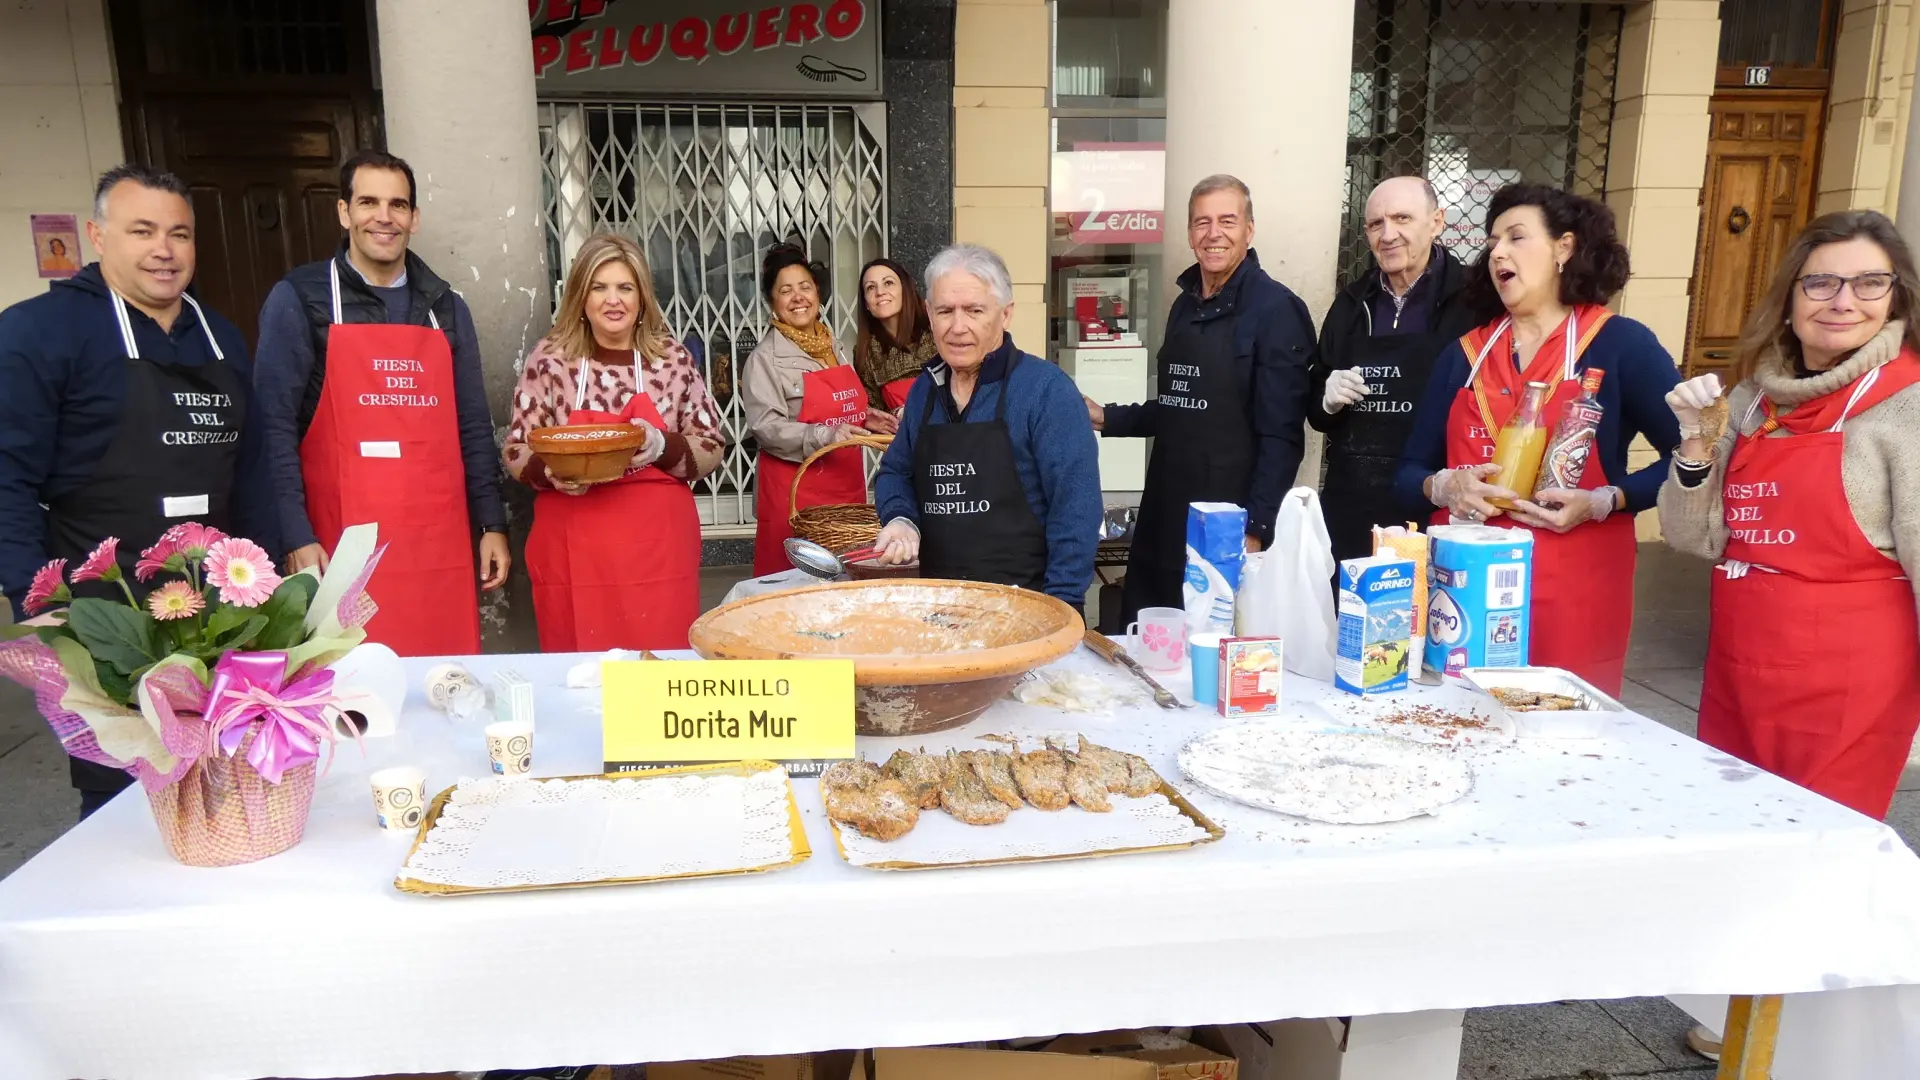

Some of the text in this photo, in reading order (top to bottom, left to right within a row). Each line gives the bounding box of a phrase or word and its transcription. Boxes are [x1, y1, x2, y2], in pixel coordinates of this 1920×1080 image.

[532, 0, 866, 79] PELUQUERO
[1750, 68, 1767, 84] 16
[371, 359, 424, 372] FIESTA
[1168, 363, 1200, 377] FIESTA
[1360, 366, 1402, 378] IESTA
[385, 376, 418, 389] DEL
[1171, 379, 1190, 392] DEL
[1366, 383, 1388, 395] EL
[172, 392, 232, 407] FIESTA
[358, 393, 438, 406] CRESPILLO
[832, 388, 859, 401] FIESTA
[1158, 394, 1208, 409] CRESPILLO
[842, 401, 857, 412] DEL
[1351, 401, 1413, 413] ESPILLO
[188, 412, 225, 426] DEL
[162, 431, 238, 445] CRESPILLO
[929, 462, 977, 476] FIESTA
[935, 482, 966, 496] DEL
[1723, 482, 1779, 499] IESTA
[924, 499, 990, 514] CRESPILLO
[1369, 578, 1412, 592] COPIRINEO
[668, 679, 790, 697] HORNILLO
[663, 710, 797, 739] Dorita Mur
